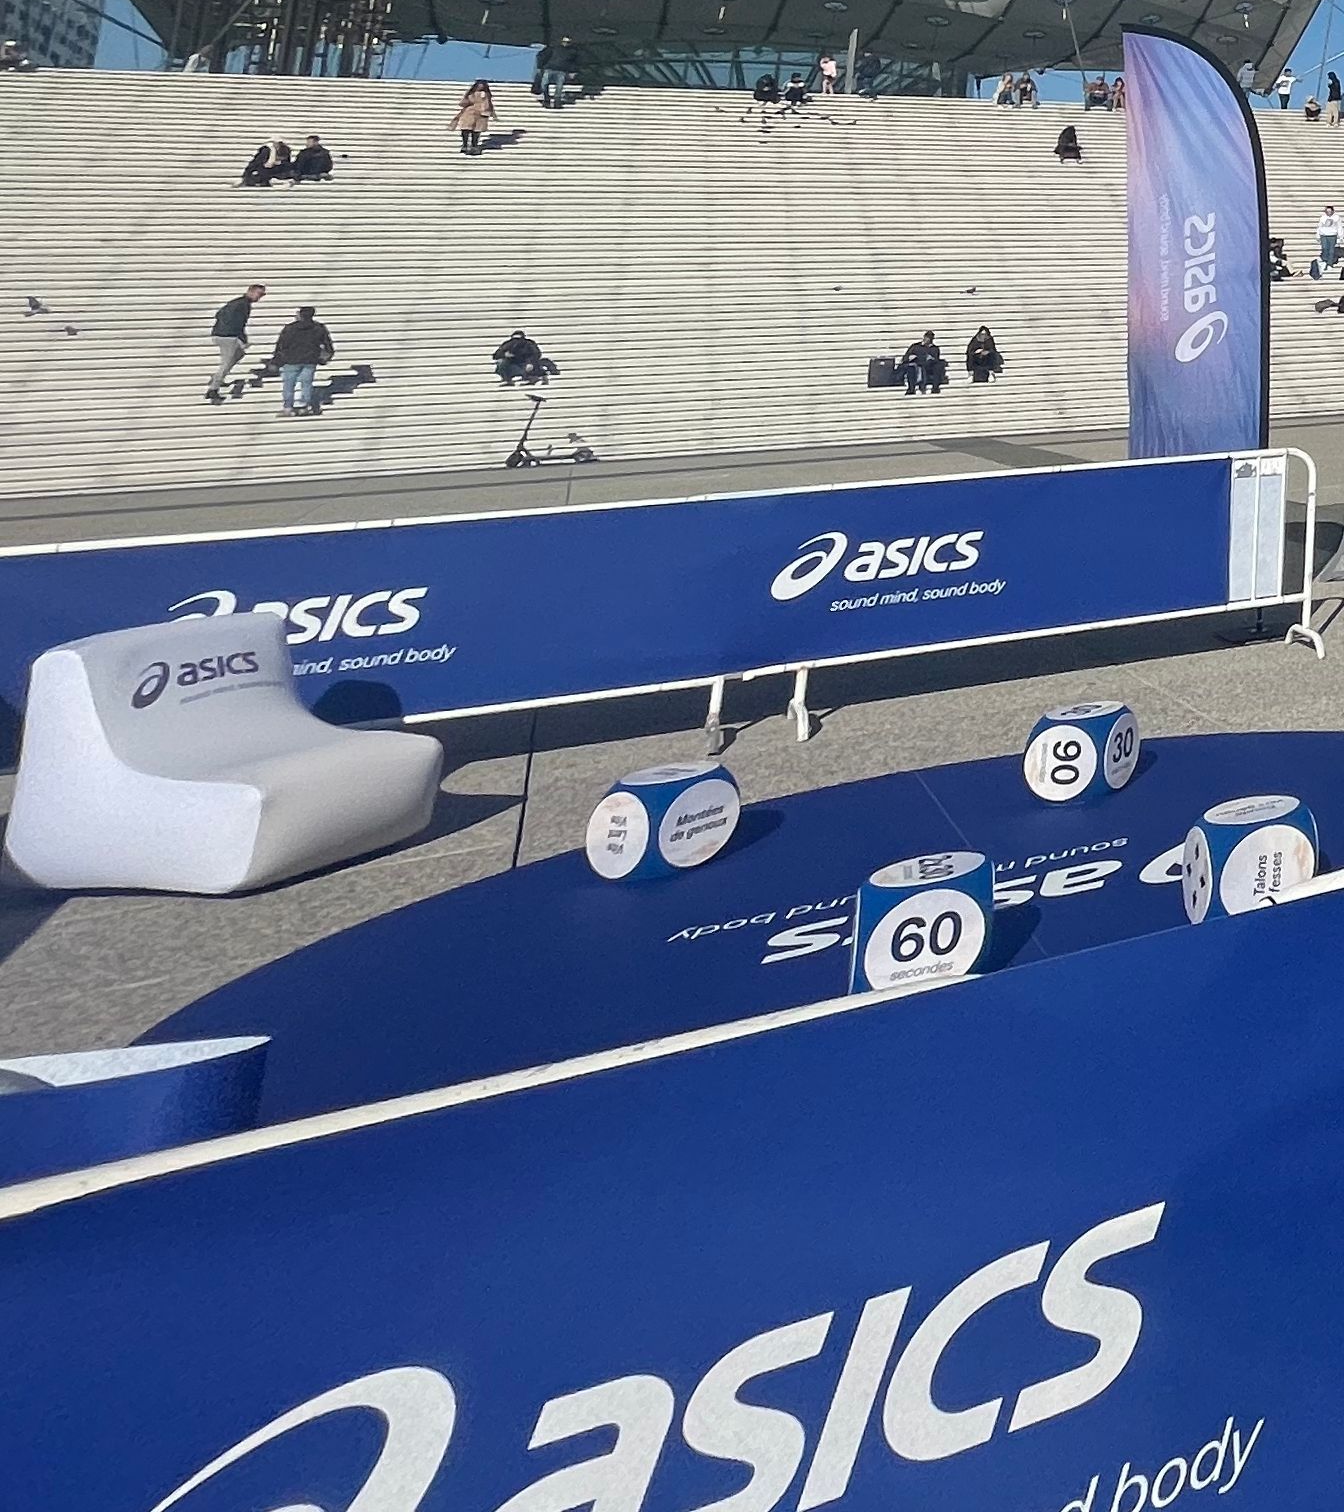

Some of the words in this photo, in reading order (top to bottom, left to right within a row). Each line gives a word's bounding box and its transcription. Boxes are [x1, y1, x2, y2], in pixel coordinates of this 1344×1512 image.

[844, 531, 984, 582] asics
[830, 593, 880, 612] sound
[879, 588, 919, 605] mind,
[922, 582, 970, 600] sound
[969, 579, 1007, 596] body
[176, 651, 259, 687] asics
[338, 649, 403, 673] sound
[404, 644, 457, 664] body
[1112, 727, 1134, 763] 30
[669, 830, 685, 843] de
[1253, 855, 1268, 896] Talons
[667, 912, 776, 943] body
[890, 910, 963, 964] 60
[889, 960, 954, 982] secondes
[494, 1201, 1166, 1512] asics
[1109, 1416, 1266, 1512] body
